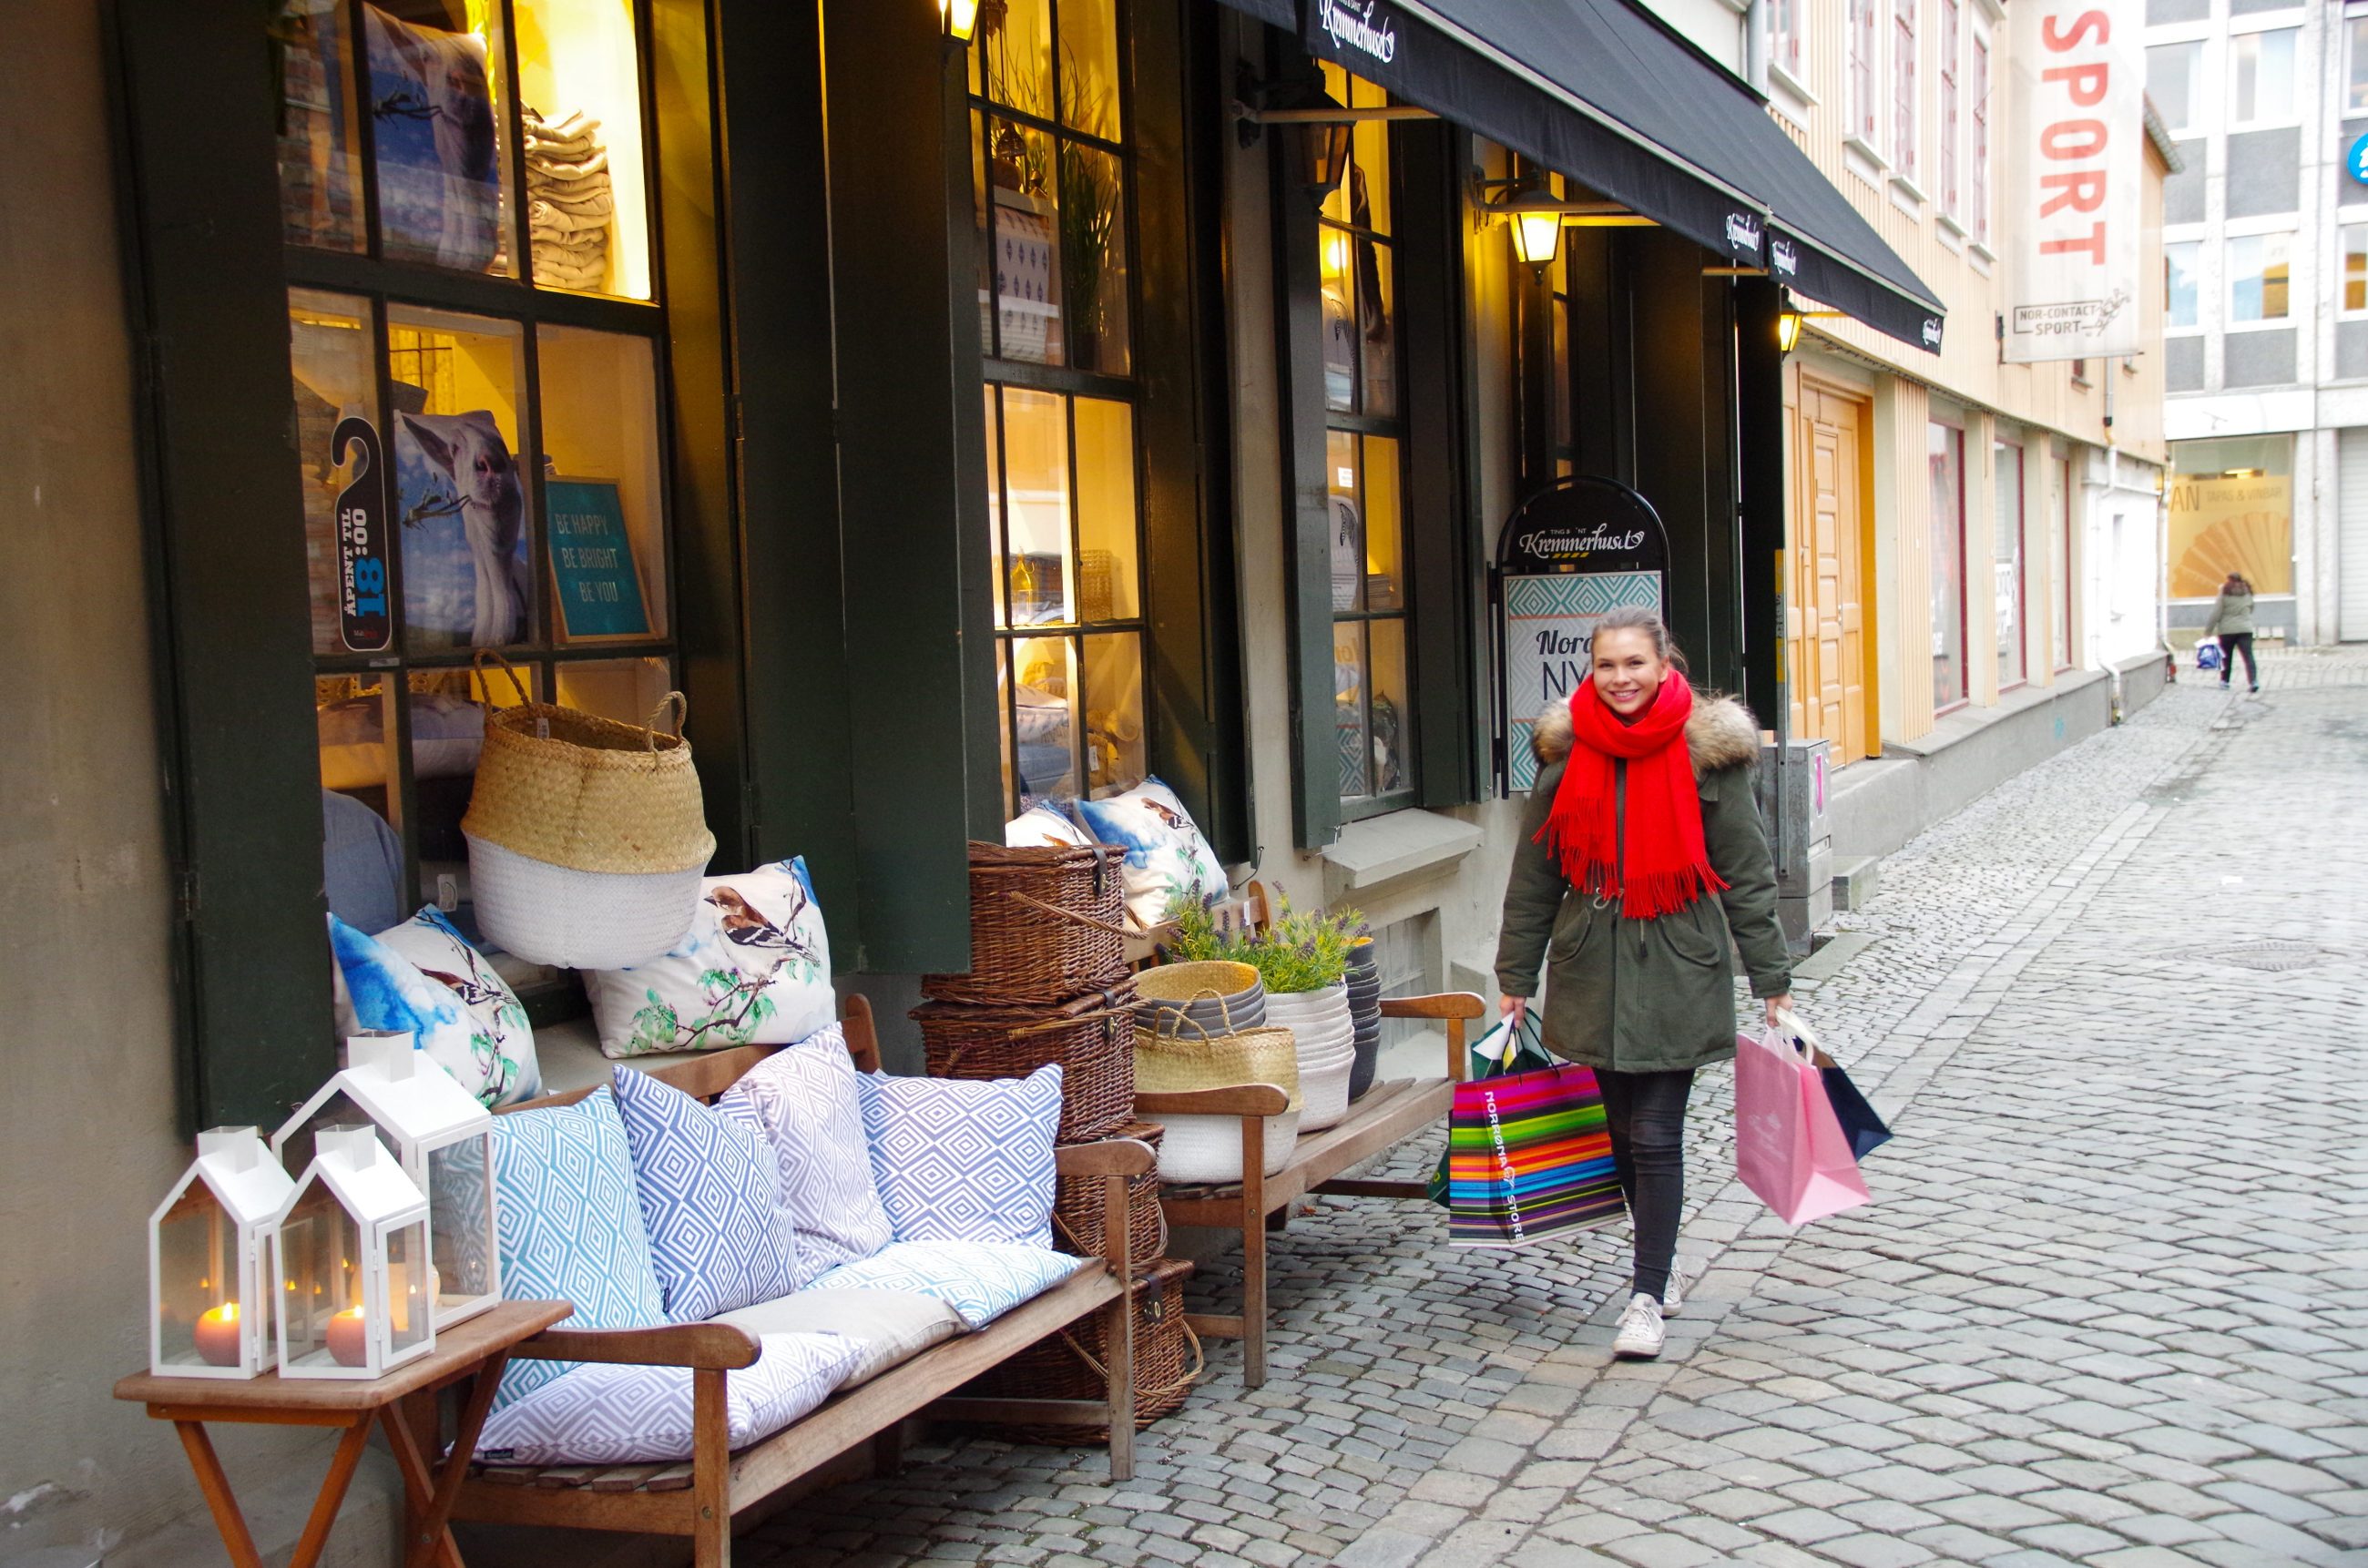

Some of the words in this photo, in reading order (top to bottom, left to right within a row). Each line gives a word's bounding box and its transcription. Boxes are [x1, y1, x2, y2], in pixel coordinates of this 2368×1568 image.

[2039, 9, 2110, 266] SPORT
[2019, 305, 2097, 321] NOR-CONTACT
[2035, 321, 2081, 336] SPORT
[341, 508, 352, 542] TIL
[554, 513, 572, 535] BE
[571, 514, 608, 535] HAPPY
[352, 508, 386, 617] 18:00
[561, 547, 577, 568] BE
[577, 547, 618, 568] BRIGHT
[344, 546, 356, 616] ÅPENT
[578, 581, 595, 602] BE
[595, 581, 618, 602] YOU
[1485, 1091, 1508, 1168] NORRØNA
[1507, 1194, 1525, 1243] STORE
